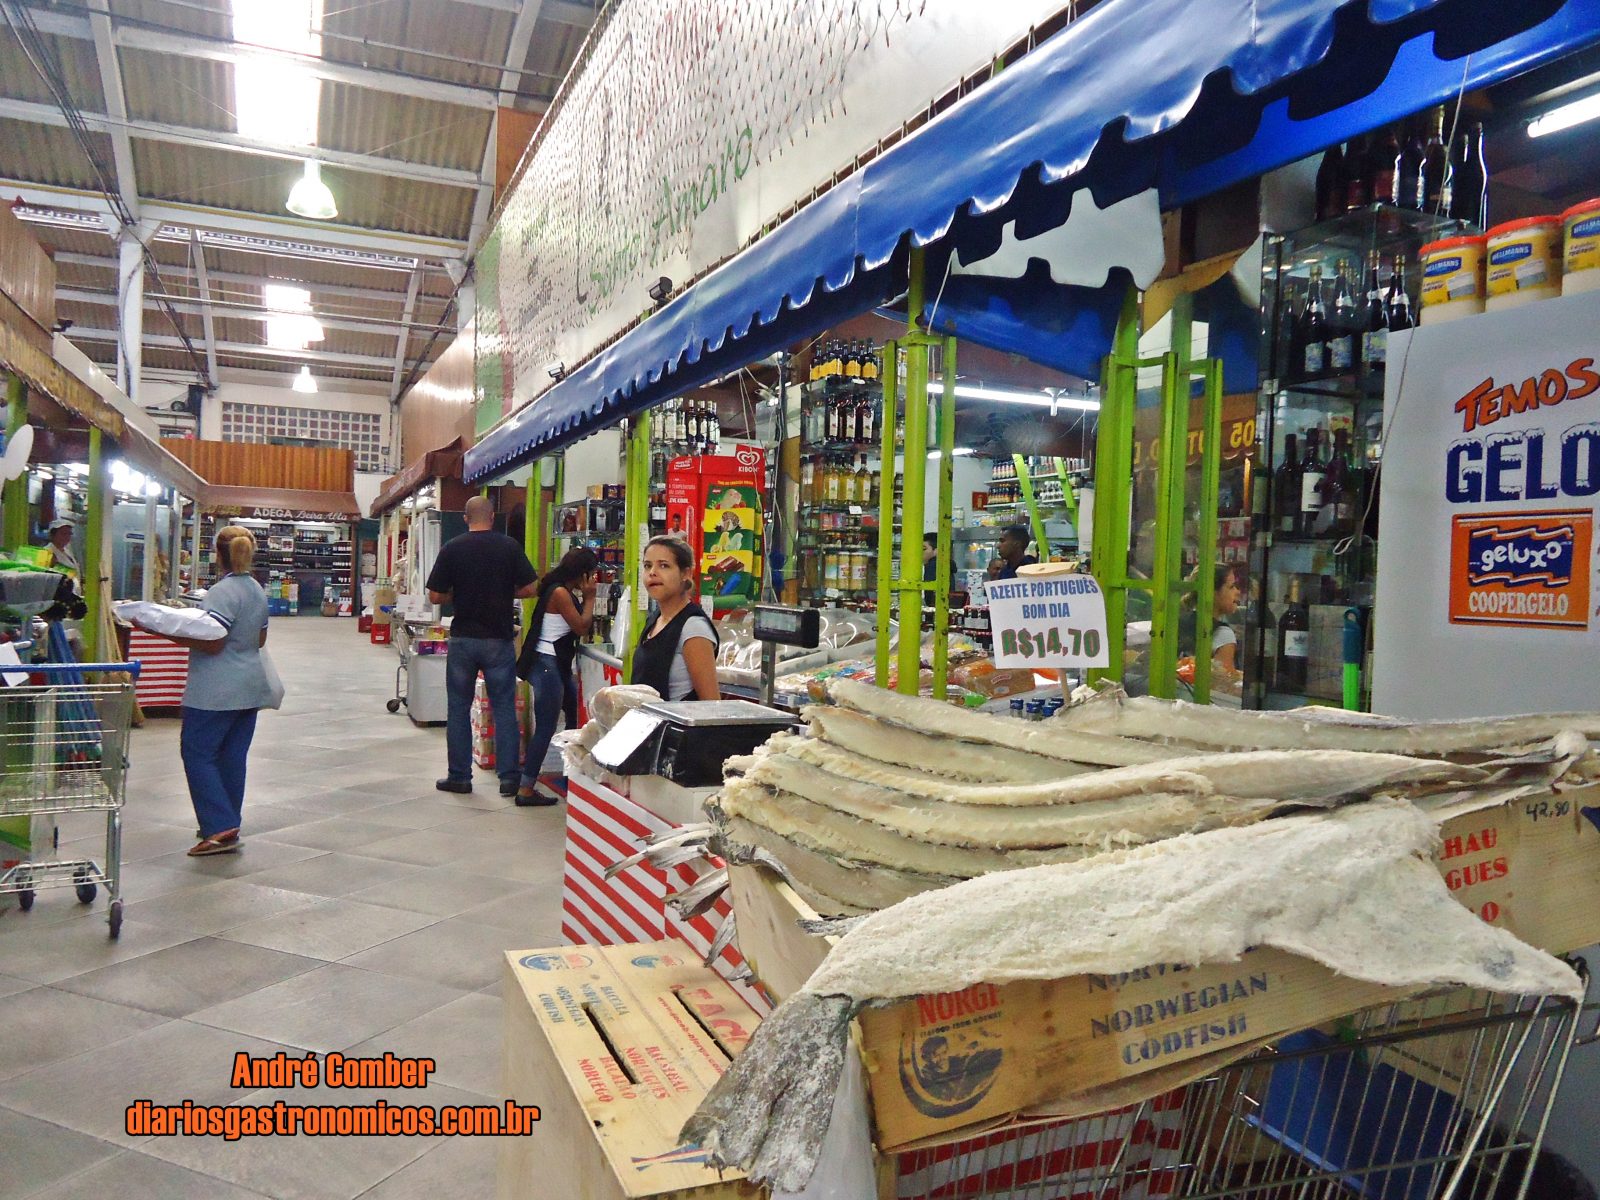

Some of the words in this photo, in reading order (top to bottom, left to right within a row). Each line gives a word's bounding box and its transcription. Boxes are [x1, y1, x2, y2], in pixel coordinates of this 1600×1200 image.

[651, 126, 753, 268] Amaro
[1454, 358, 1600, 432] TEMOS
[1446, 421, 1600, 504] GELO
[253, 507, 293, 518] ADEGA
[990, 583, 1029, 600] AZEITE
[1030, 577, 1099, 598] PORTUGUÊS
[1468, 591, 1569, 616] COOPERGELO
[1022, 604, 1047, 619] BOM
[1050, 602, 1071, 618] DIA
[1001, 627, 1101, 659] R$14,70
[1440, 828, 1498, 860] HAU
[1445, 856, 1509, 891] GUES
[1090, 972, 1268, 1039] NORWEGIAN
[1122, 1013, 1248, 1065] CODFISH
